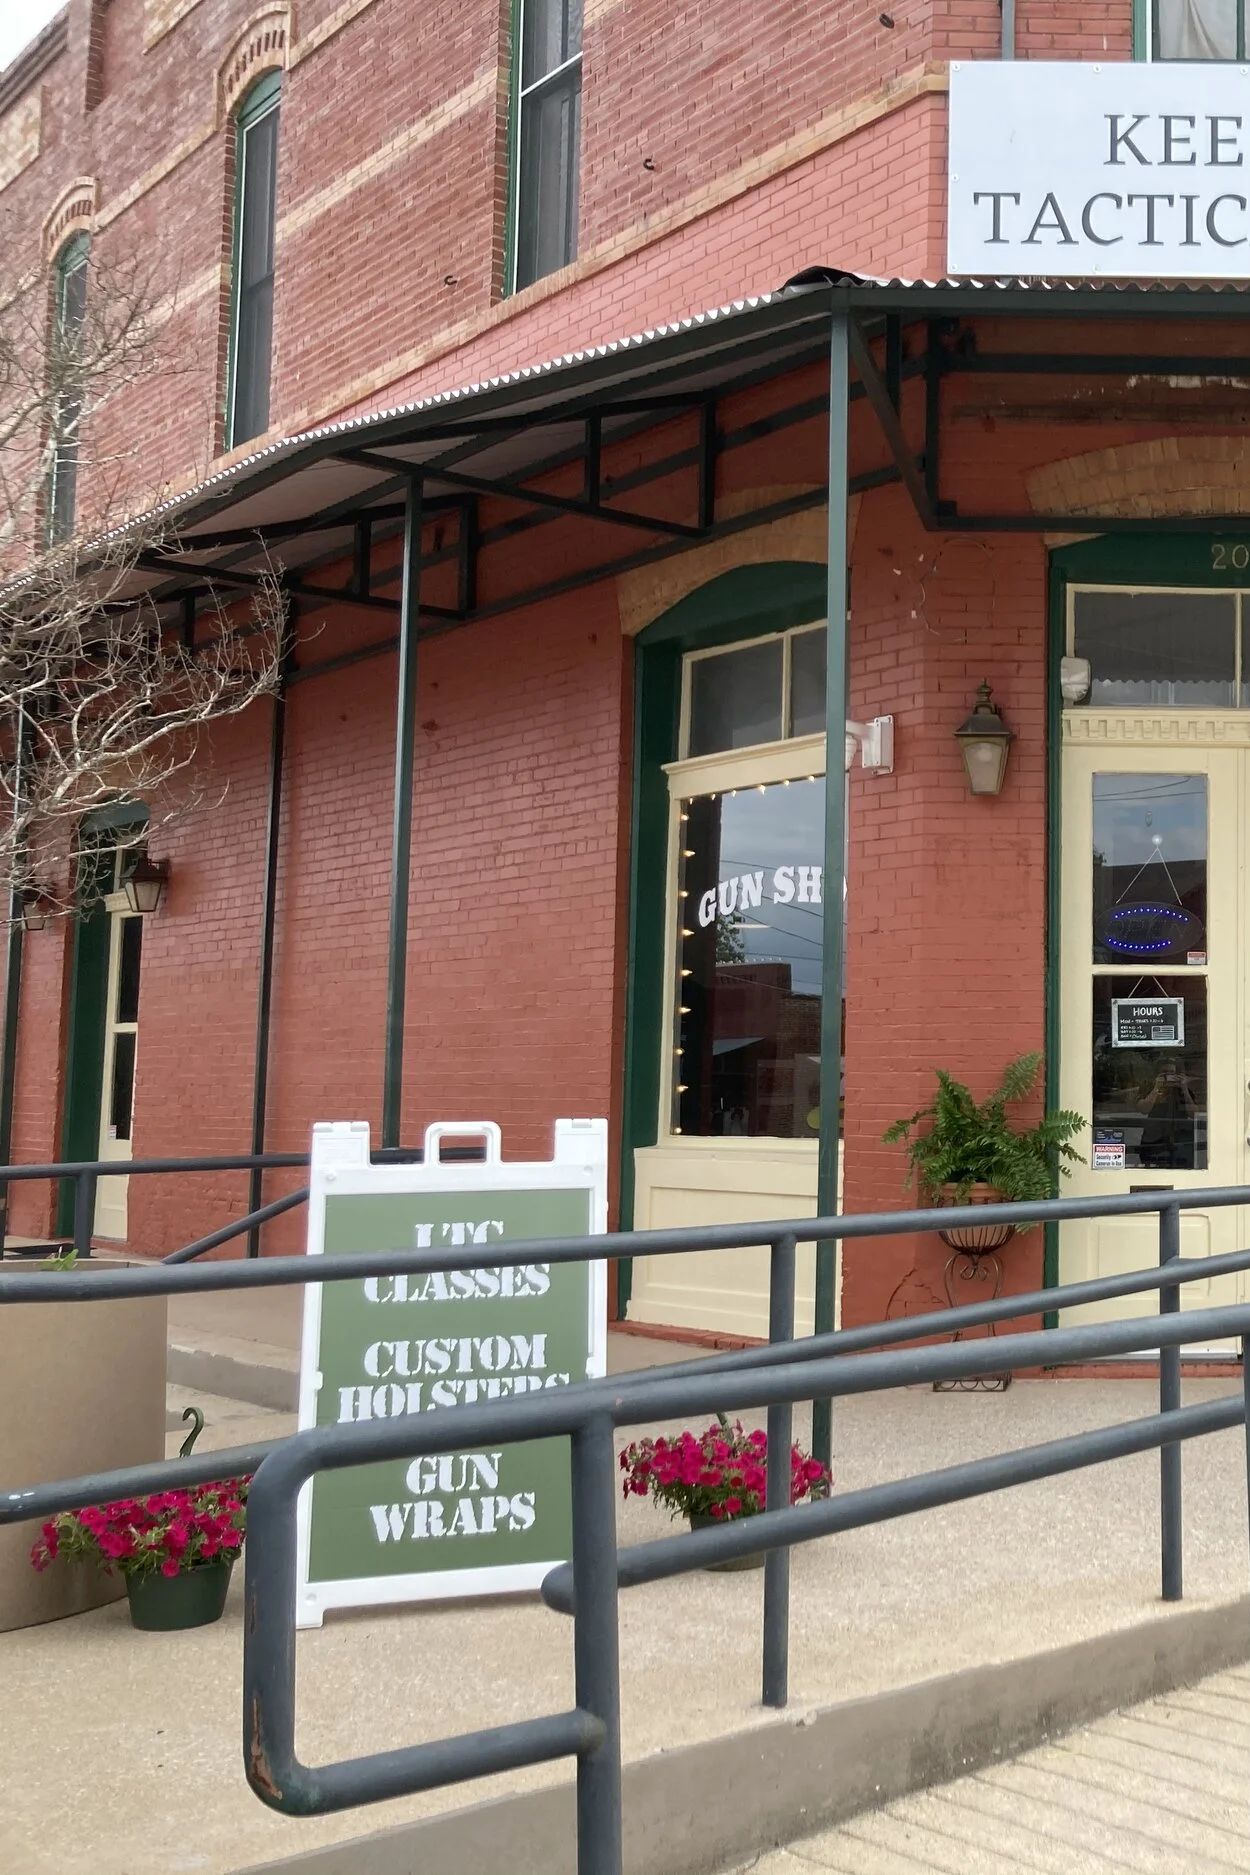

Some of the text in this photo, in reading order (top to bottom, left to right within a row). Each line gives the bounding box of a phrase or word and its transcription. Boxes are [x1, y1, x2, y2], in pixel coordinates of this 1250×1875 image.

[698, 870, 765, 928] GUN
[1132, 1006, 1164, 1017] HOURS
[363, 1263, 551, 1303] CLASSES
[363, 1333, 548, 1378] CUSTOM
[405, 1453, 503, 1495] GUN
[369, 1491, 537, 1544] WRAPS
